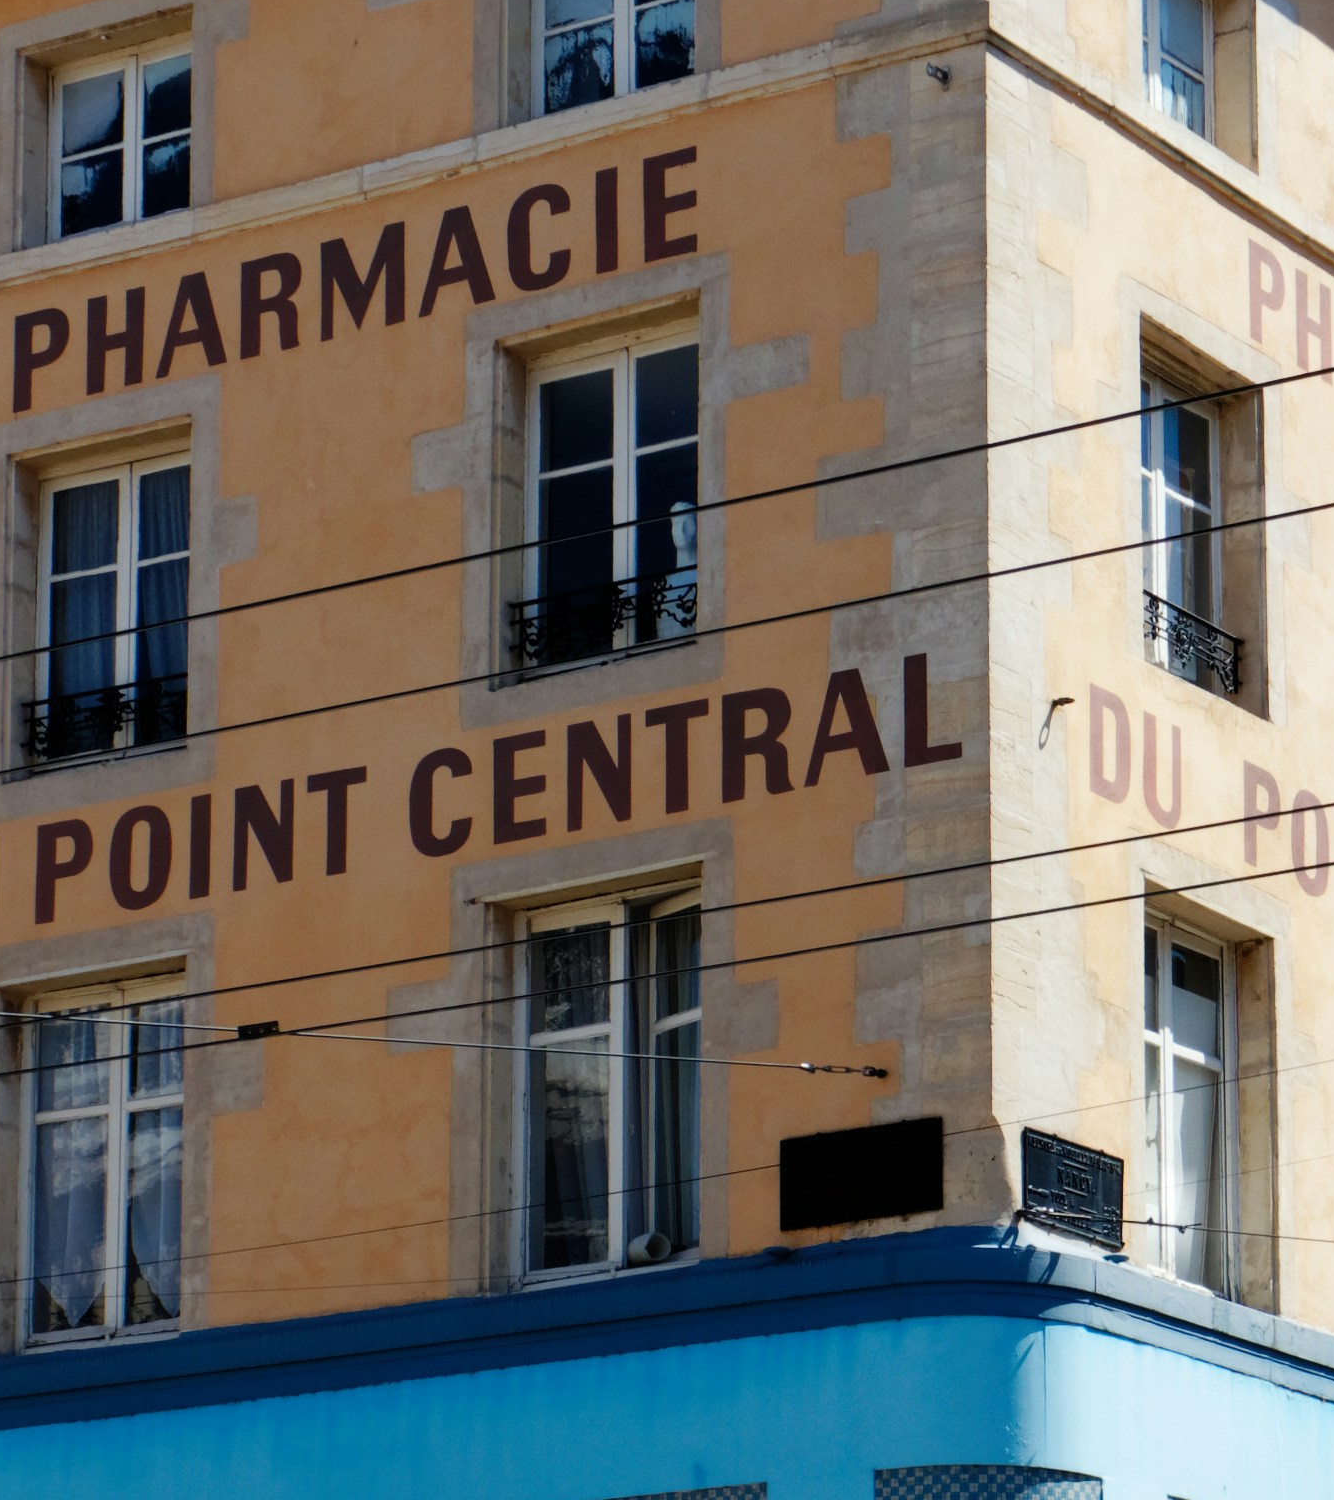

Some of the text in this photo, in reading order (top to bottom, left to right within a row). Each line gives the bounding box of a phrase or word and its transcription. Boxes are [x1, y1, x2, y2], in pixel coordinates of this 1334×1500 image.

[12, 146, 698, 412] PHARMACIE
[34, 766, 367, 924] POINT
[408, 653, 962, 857] CENTRAL
[1088, 683, 1181, 830] DU
